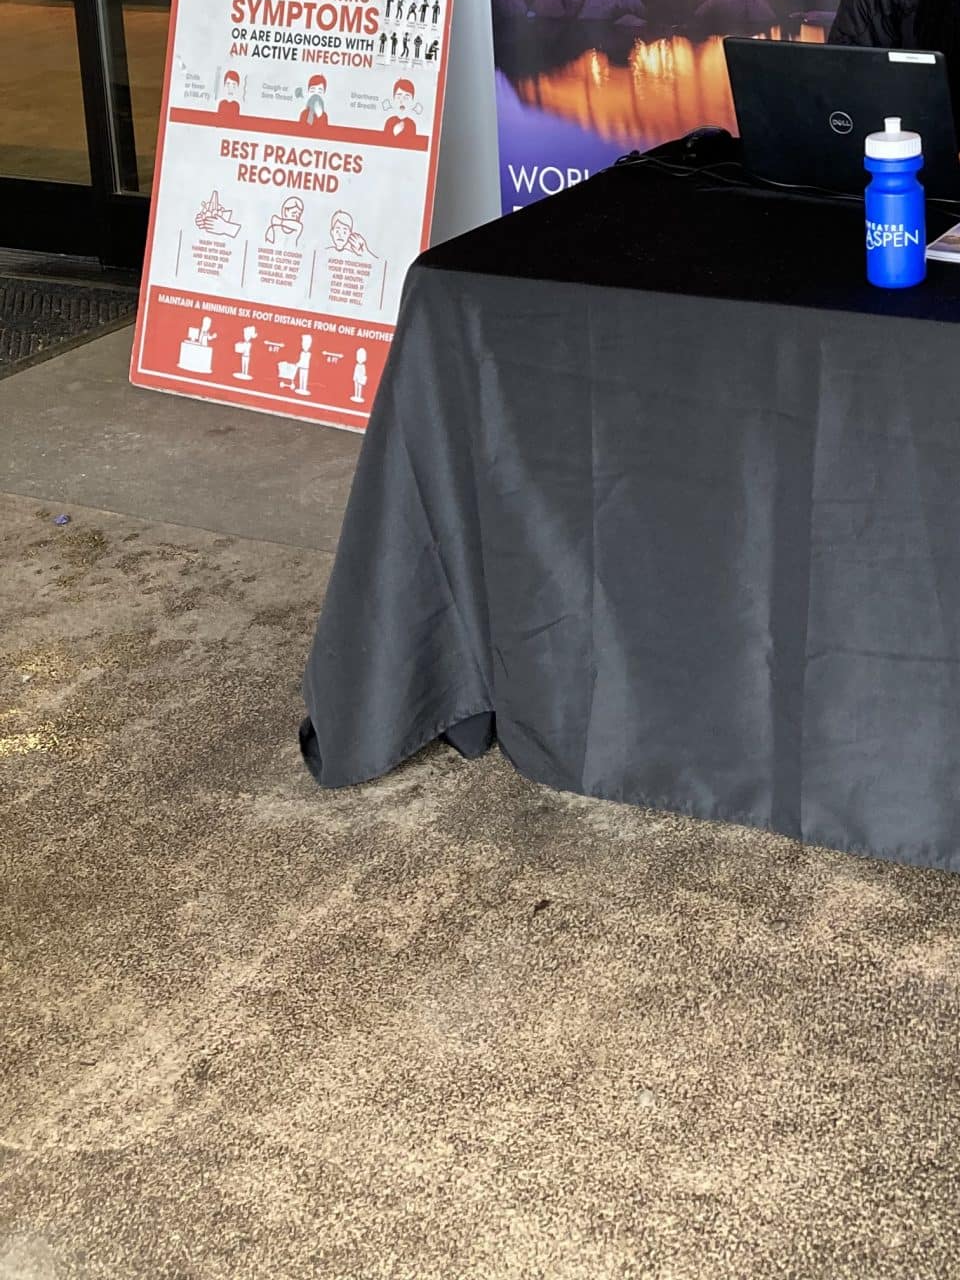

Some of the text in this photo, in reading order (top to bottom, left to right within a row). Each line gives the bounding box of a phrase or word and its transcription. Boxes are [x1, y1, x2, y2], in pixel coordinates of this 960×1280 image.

[231, 27, 375, 52] OR ARE DIAGNOSED WITH
[229, 42, 248, 58] AN
[251, 44, 298, 62] ACTIVE
[302, 48, 374, 68] INFECTION
[220, 139, 363, 174] BEST PRACTICES
[237, 164, 339, 194] RECOMEND
[867, 229, 918, 248] ASPEN
[158, 294, 194, 308] MAINTAIN
[194, 300, 200, 308] A
[202, 301, 236, 316] MINIMUM
[238, 306, 250, 318] SIX
[252, 310, 272, 322] FOOT
[274, 314, 312, 329] DISTANCE
[314, 319, 336, 334] FROM
[338, 324, 354, 336] ONE
